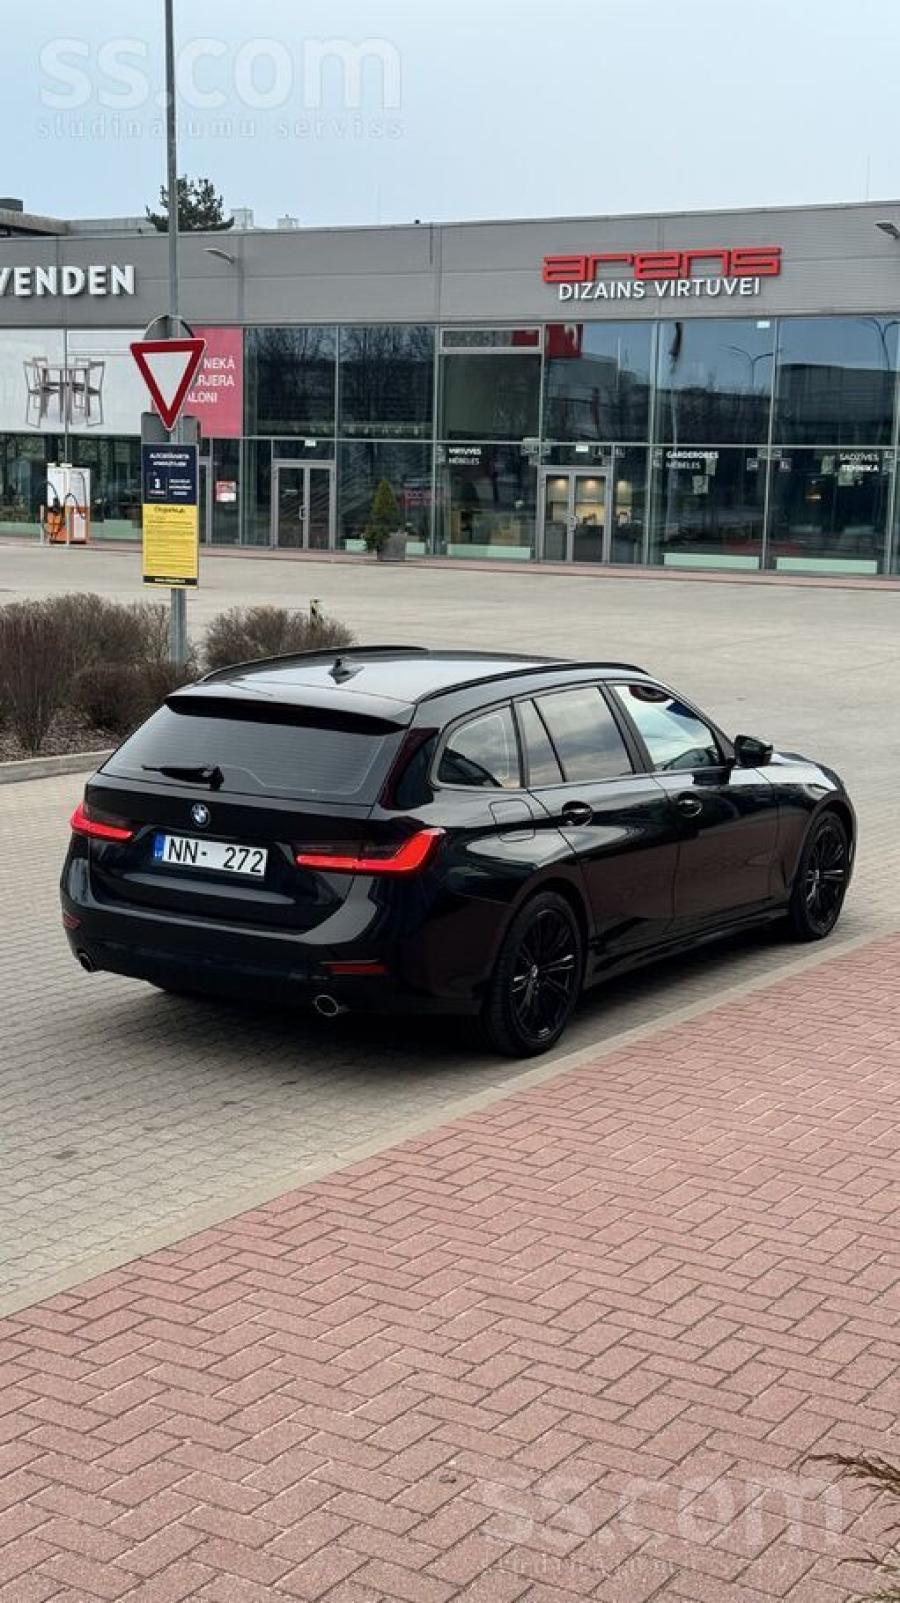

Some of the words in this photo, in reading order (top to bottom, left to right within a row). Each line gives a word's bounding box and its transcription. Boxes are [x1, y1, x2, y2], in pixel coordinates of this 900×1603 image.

[543, 247, 782, 282] arens
[559, 281, 645, 300] DIZAINS
[655, 278, 760, 297] VIRTUVEI
[223, 846, 264, 873] 272
